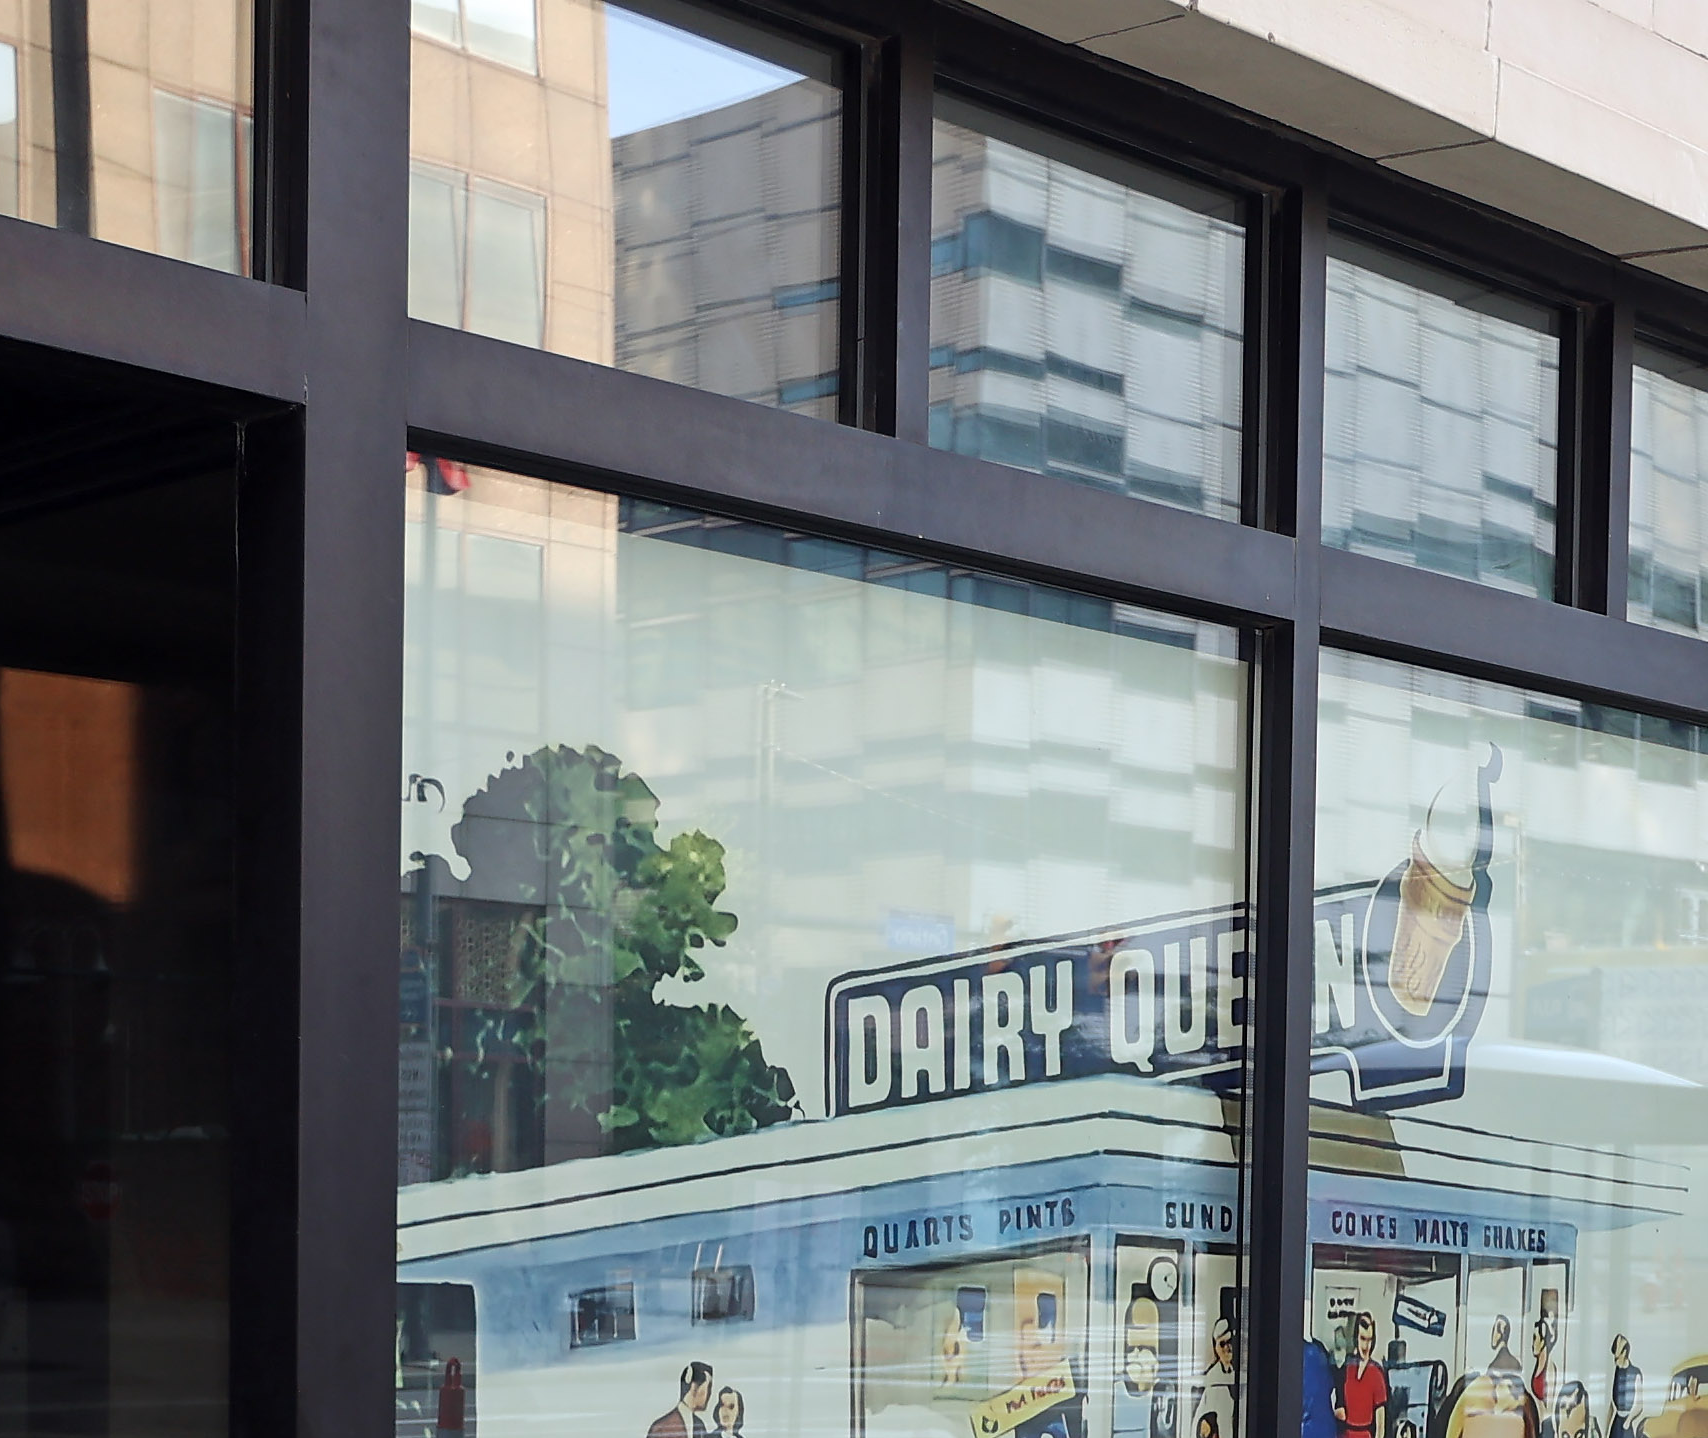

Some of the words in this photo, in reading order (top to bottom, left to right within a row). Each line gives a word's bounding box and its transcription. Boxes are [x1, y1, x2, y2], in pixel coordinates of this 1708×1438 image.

[848, 959, 1074, 1108] DAIRY
[1109, 913, 1356, 1072] QUEN
[863, 1214, 974, 1258] QUARTS
[998, 1197, 1075, 1235] PINTS
[1164, 1201, 1234, 1234] SUND
[1330, 1210, 1398, 1241] CONES
[1414, 1218, 1469, 1248] MALTS
[1483, 1225, 1547, 1254] SHAKES
